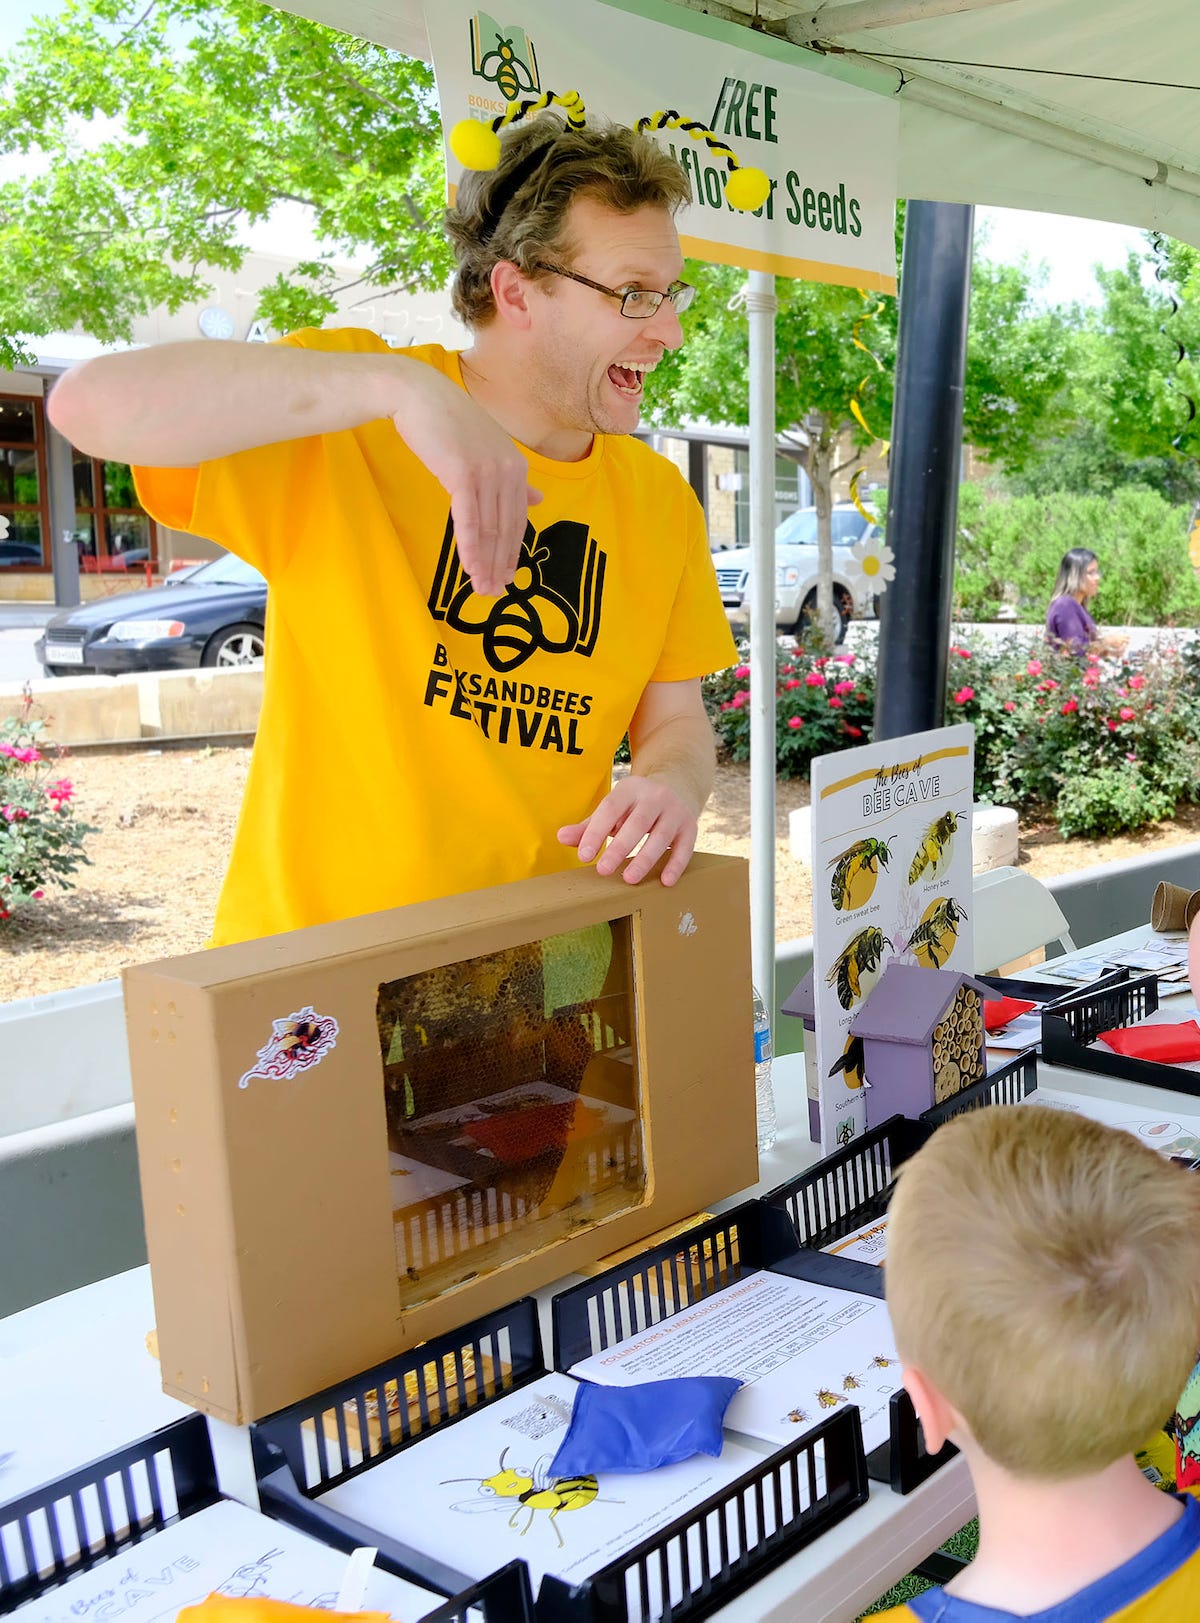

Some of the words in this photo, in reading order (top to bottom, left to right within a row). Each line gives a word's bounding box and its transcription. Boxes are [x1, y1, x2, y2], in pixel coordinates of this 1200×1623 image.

[709, 76, 778, 143] FREE
[785, 170, 862, 238] Seeds
[424, 670, 584, 755] FETIVAL
[863, 788, 891, 817] BEE
[894, 776, 940, 806] CAVE
[873, 765, 888, 791] The
[891, 764, 909, 785] Bees
[836, 909, 853, 926] Green
[600, 1332, 663, 1365] POLLINATORS
[670, 1297, 729, 1328] MIRACULOUS
